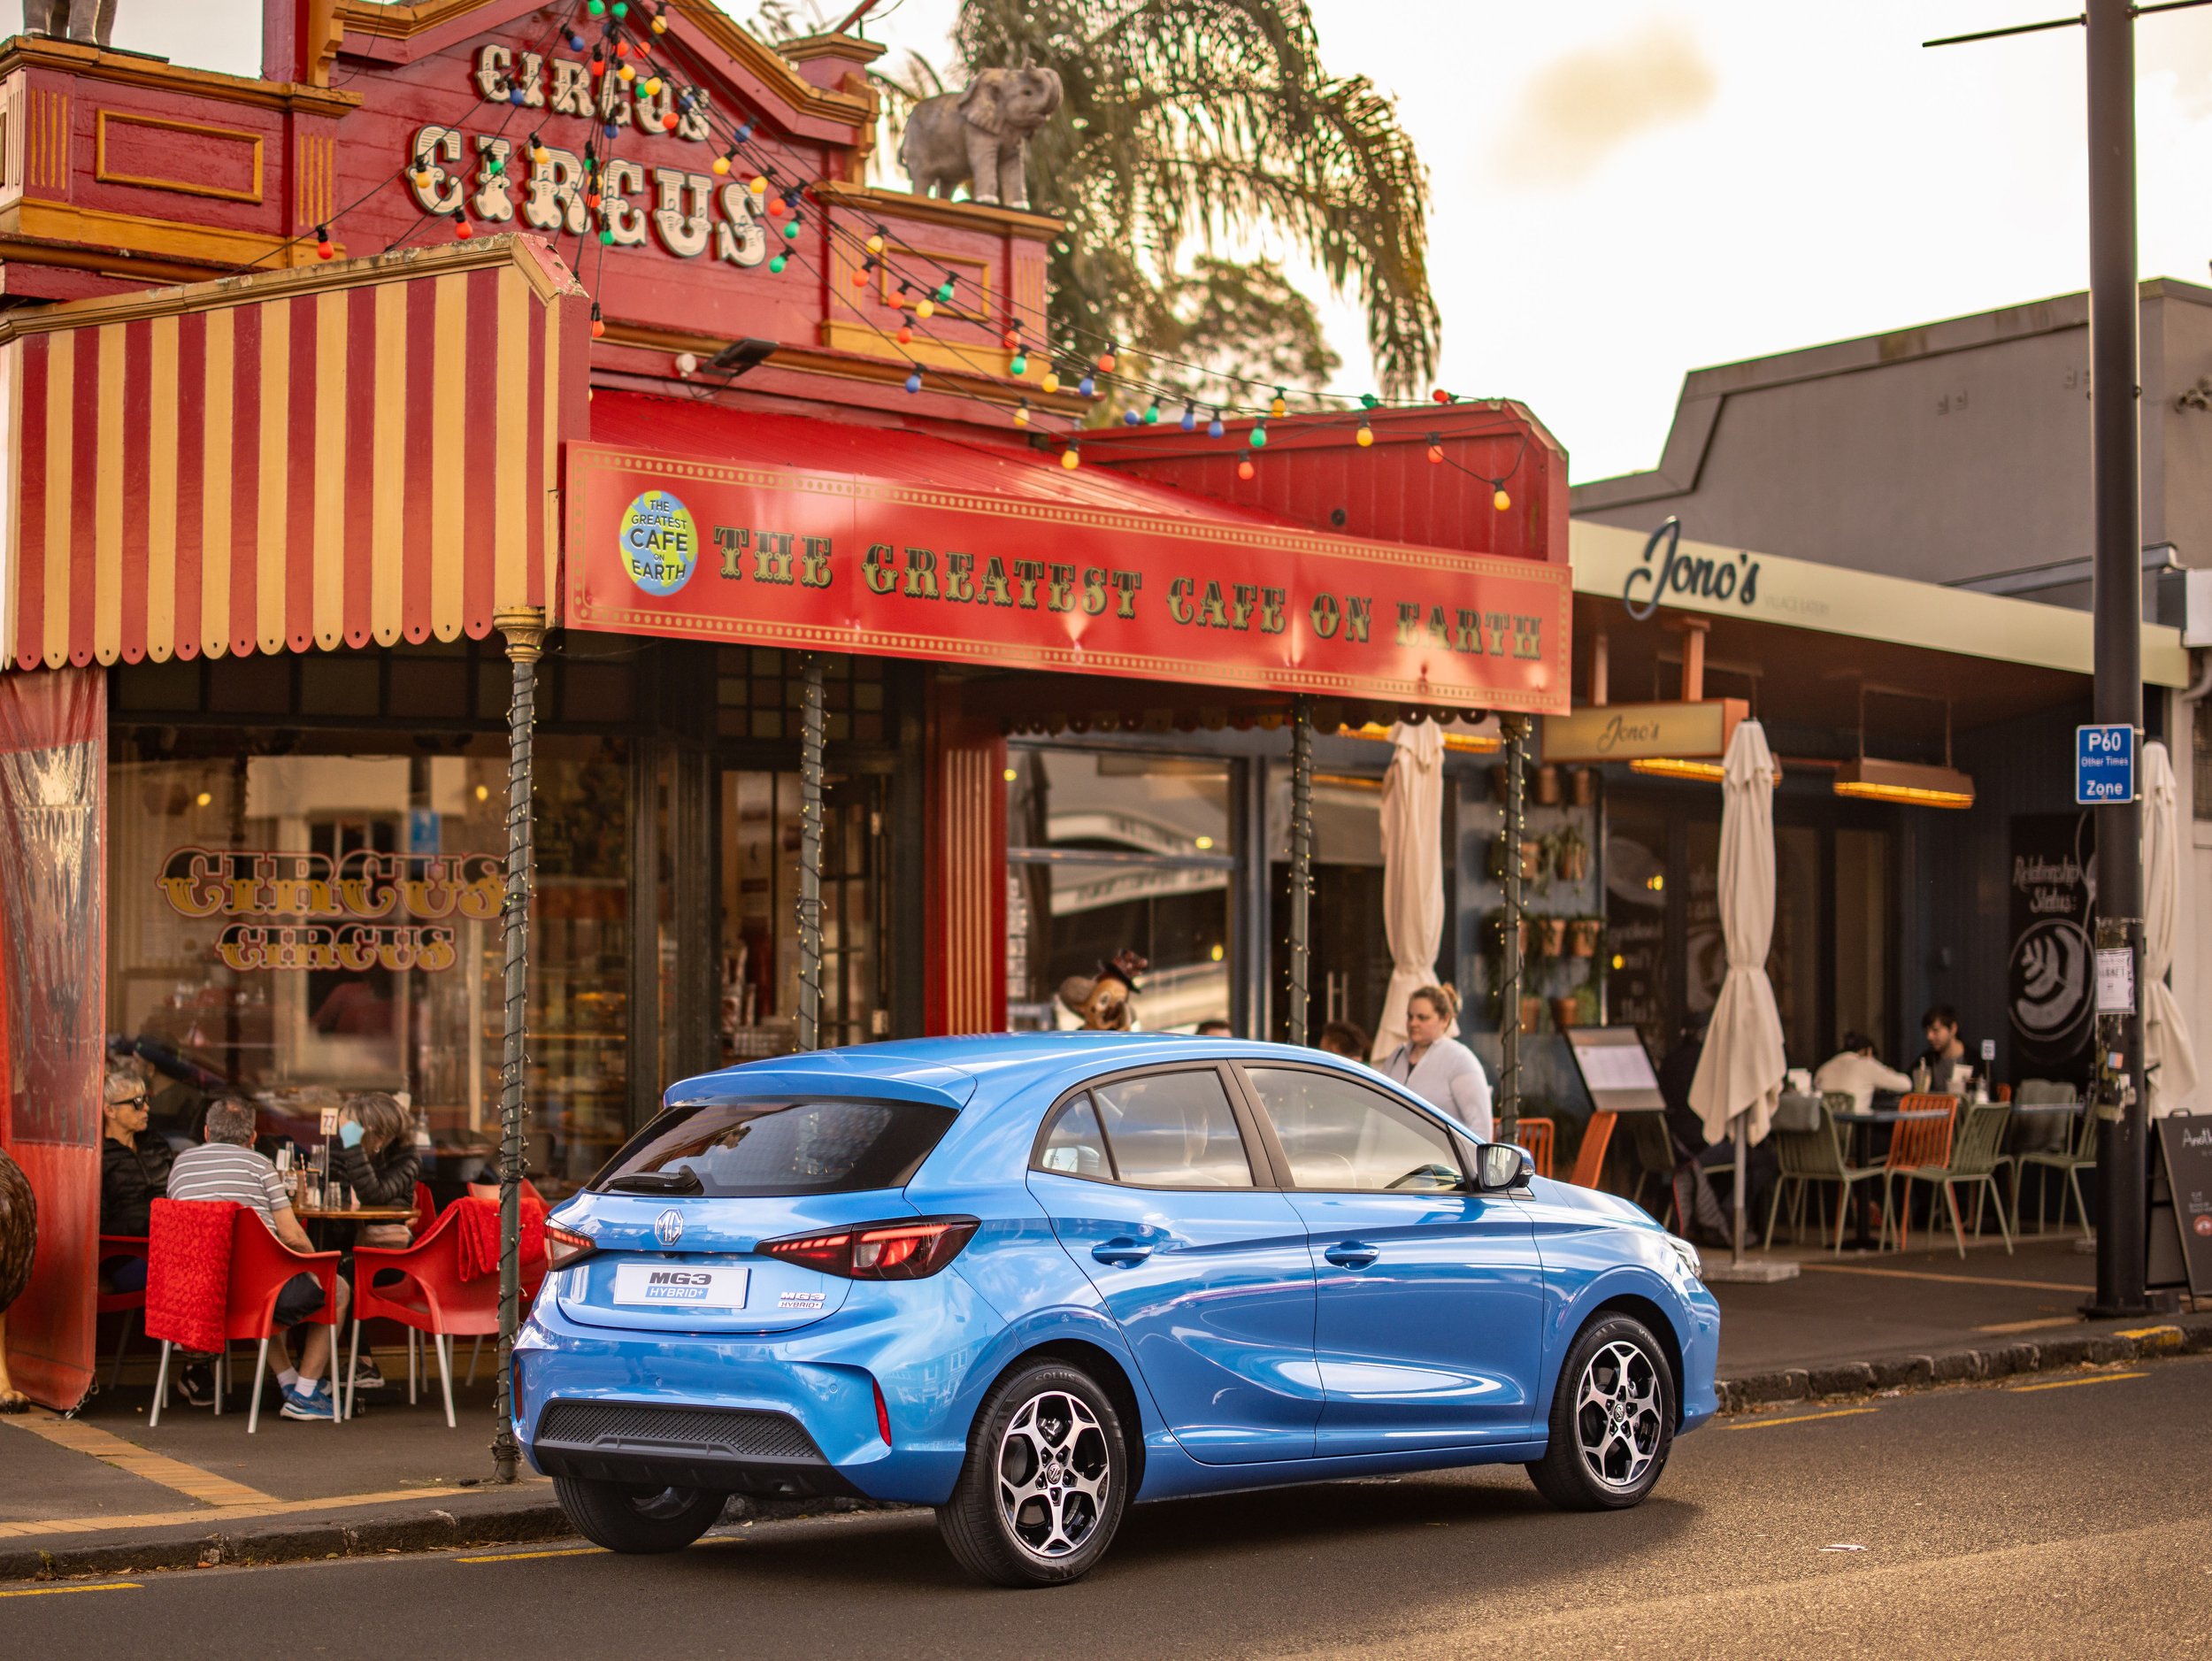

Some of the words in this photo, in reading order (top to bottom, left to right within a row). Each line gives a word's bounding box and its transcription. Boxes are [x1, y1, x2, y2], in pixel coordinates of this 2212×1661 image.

[476, 43, 710, 142] CIRCUS
[408, 124, 766, 267] CIRCUS
[649, 500, 670, 513] THE
[631, 514, 687, 531] GREATEST
[629, 528, 688, 553] CAFE
[653, 553, 664, 563] ON
[1623, 514, 1761, 621] Jono's
[632, 559, 687, 581] EARTH
[713, 525, 833, 590] THE
[862, 542, 1142, 619] GREATEST
[1166, 576, 1286, 635] CAFE
[1309, 592, 1372, 643] ON
[1395, 601, 1543, 662] EARTH
[1597, 714, 1661, 753] Jono's
[2089, 732, 2122, 752] P60
[2081, 756, 2104, 768] Other
[2106, 755, 2129, 767] Times
[2086, 780, 2124, 796] Zone
[156, 846, 509, 919] CIRCUS
[216, 923, 457, 971] CIRCUS
[656, 1210, 682, 1243] MG
[649, 1272, 712, 1286] MG3
[649, 1287, 704, 1298] HYBRID+
[780, 1292, 826, 1301] MG3
[1034, 1371, 1077, 1381] SOLUS
